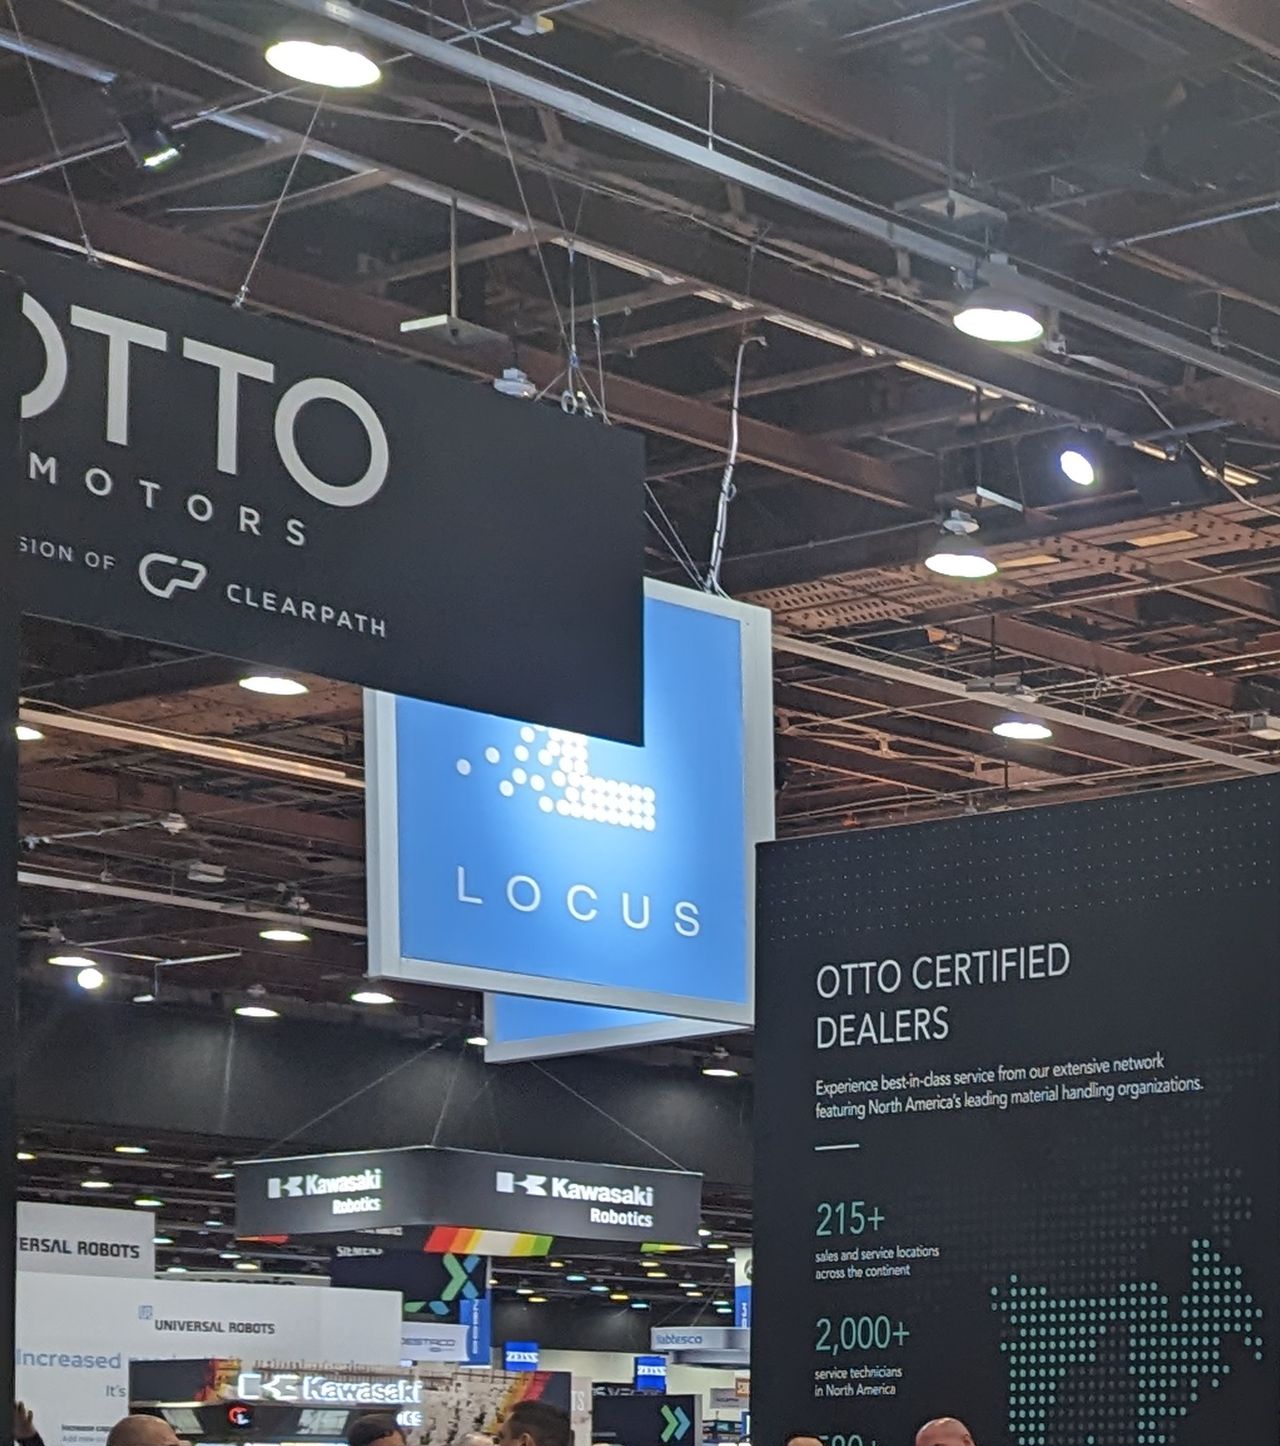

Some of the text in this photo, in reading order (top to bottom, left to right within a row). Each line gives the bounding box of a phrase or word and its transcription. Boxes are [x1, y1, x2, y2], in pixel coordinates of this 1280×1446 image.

[29, 452, 307, 547] MOTORS
[84, 551, 387, 637] OF CLEARPATH
[457, 865, 700, 938] LOCUS
[816, 942, 1071, 1000] OTTO CERTIFIED
[816, 1006, 950, 1049] DEALERS
[816, 1052, 1165, 1097] Experience best-in-class service from our extensive network
[816, 1077, 1203, 1120] featuring North America's leading material handling organizations.
[305, 1169, 383, 1196] Kawasaki
[551, 1176, 654, 1207] Kawasaki
[332, 1197, 381, 1215] Robotics
[590, 1208, 653, 1228] Robotics
[816, 1201, 885, 1236] 215+
[19, 1237, 140, 1259] ERSAL ROBOTS
[815, 1245, 940, 1263] sales and service locations
[815, 1264, 911, 1280] across the continent
[155, 1320, 275, 1335] UNIVERSAL ROBOTS
[816, 1315, 910, 1356] 2,000+
[16, 1350, 122, 1369] Increased
[815, 1365, 903, 1381] service technicians
[105, 1385, 127, 1398] It's
[303, 1374, 423, 1402] Kawasaki
[814, 1382, 896, 1397] in North America
